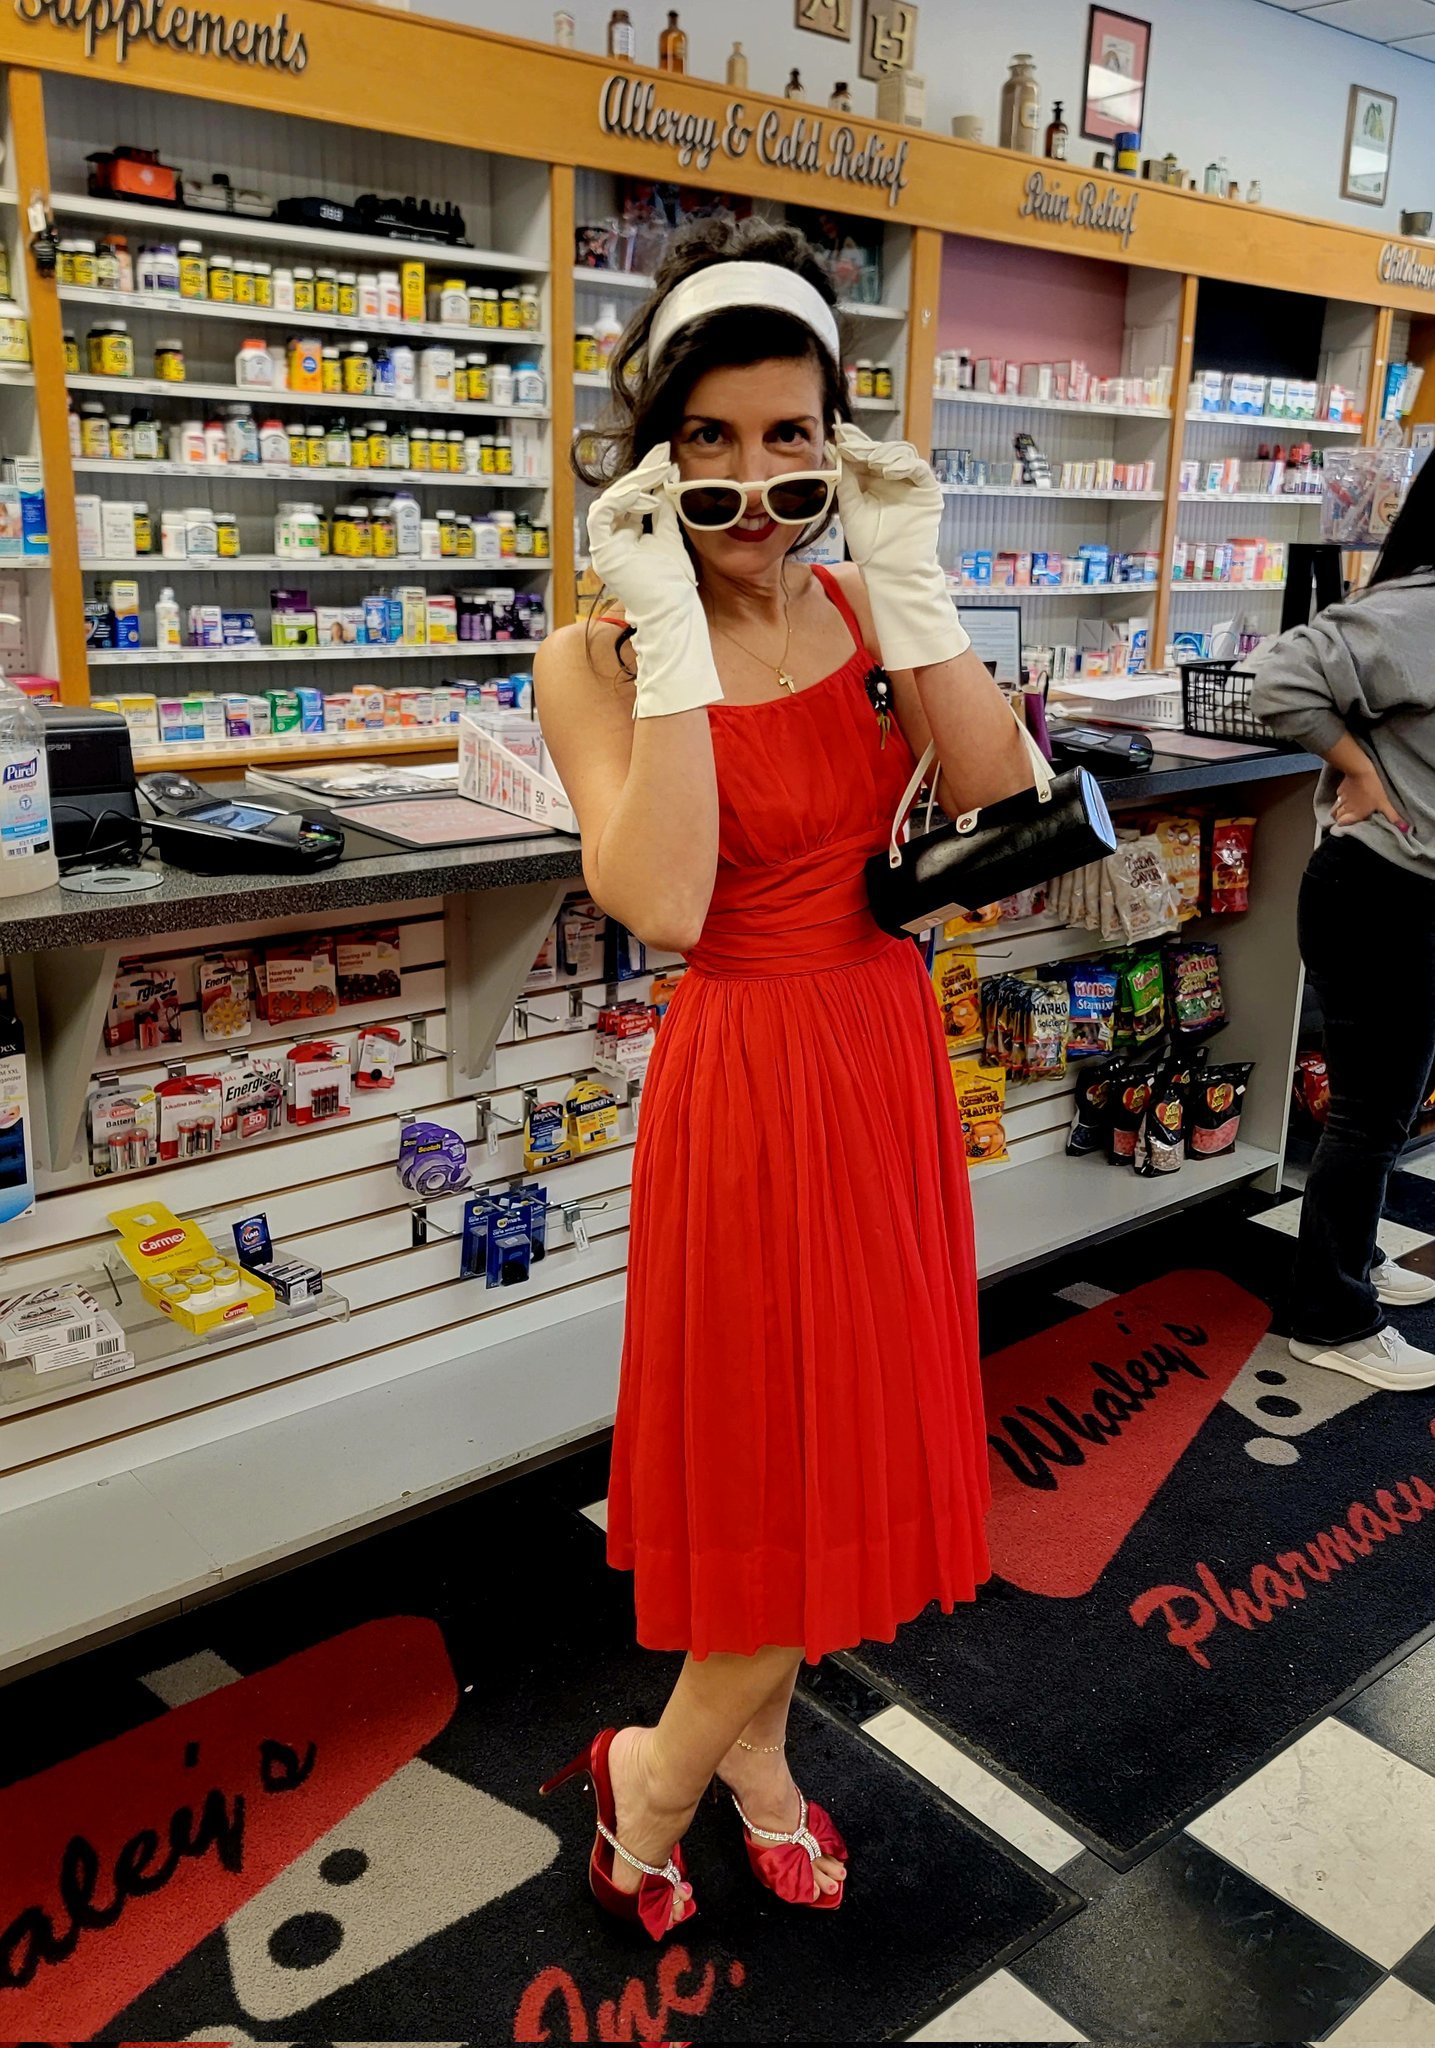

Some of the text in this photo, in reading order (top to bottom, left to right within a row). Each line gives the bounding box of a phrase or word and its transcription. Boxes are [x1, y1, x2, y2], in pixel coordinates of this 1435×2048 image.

[599, 74, 909, 208] Allergy & Cold Relief
[1019, 170, 1139, 252] Pain Relief
[7, 761, 36, 780] Purell
[418, 1143, 441, 1153] Scotch
[139, 1232, 185, 1251] Carmex
[988, 1310, 1210, 1491] Whaley's
[0, 1740, 317, 1990] aley's
